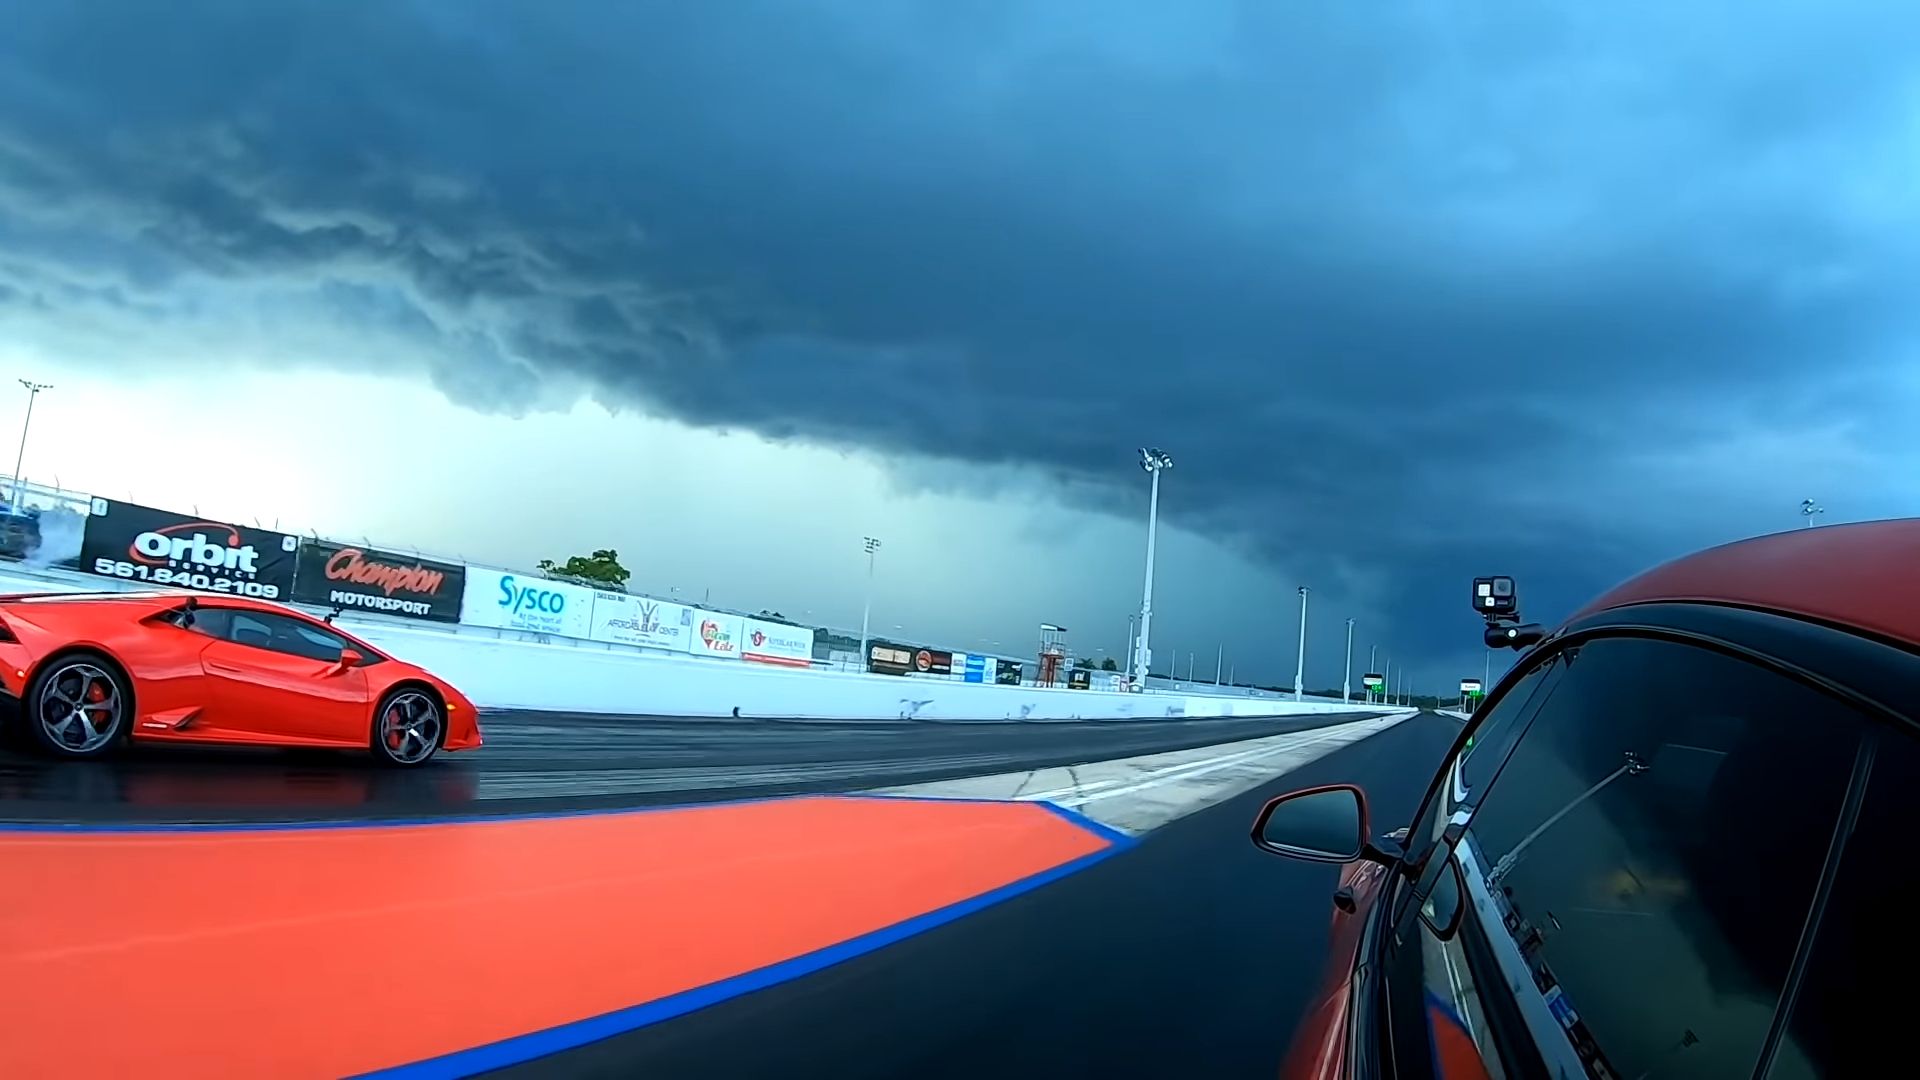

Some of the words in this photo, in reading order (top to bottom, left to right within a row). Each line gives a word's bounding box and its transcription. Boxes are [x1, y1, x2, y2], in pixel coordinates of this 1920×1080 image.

[94, 558, 279, 598] 561.840.2109
[325, 548, 443, 595] Champion
[330, 589, 432, 615] MOTORSPORT
